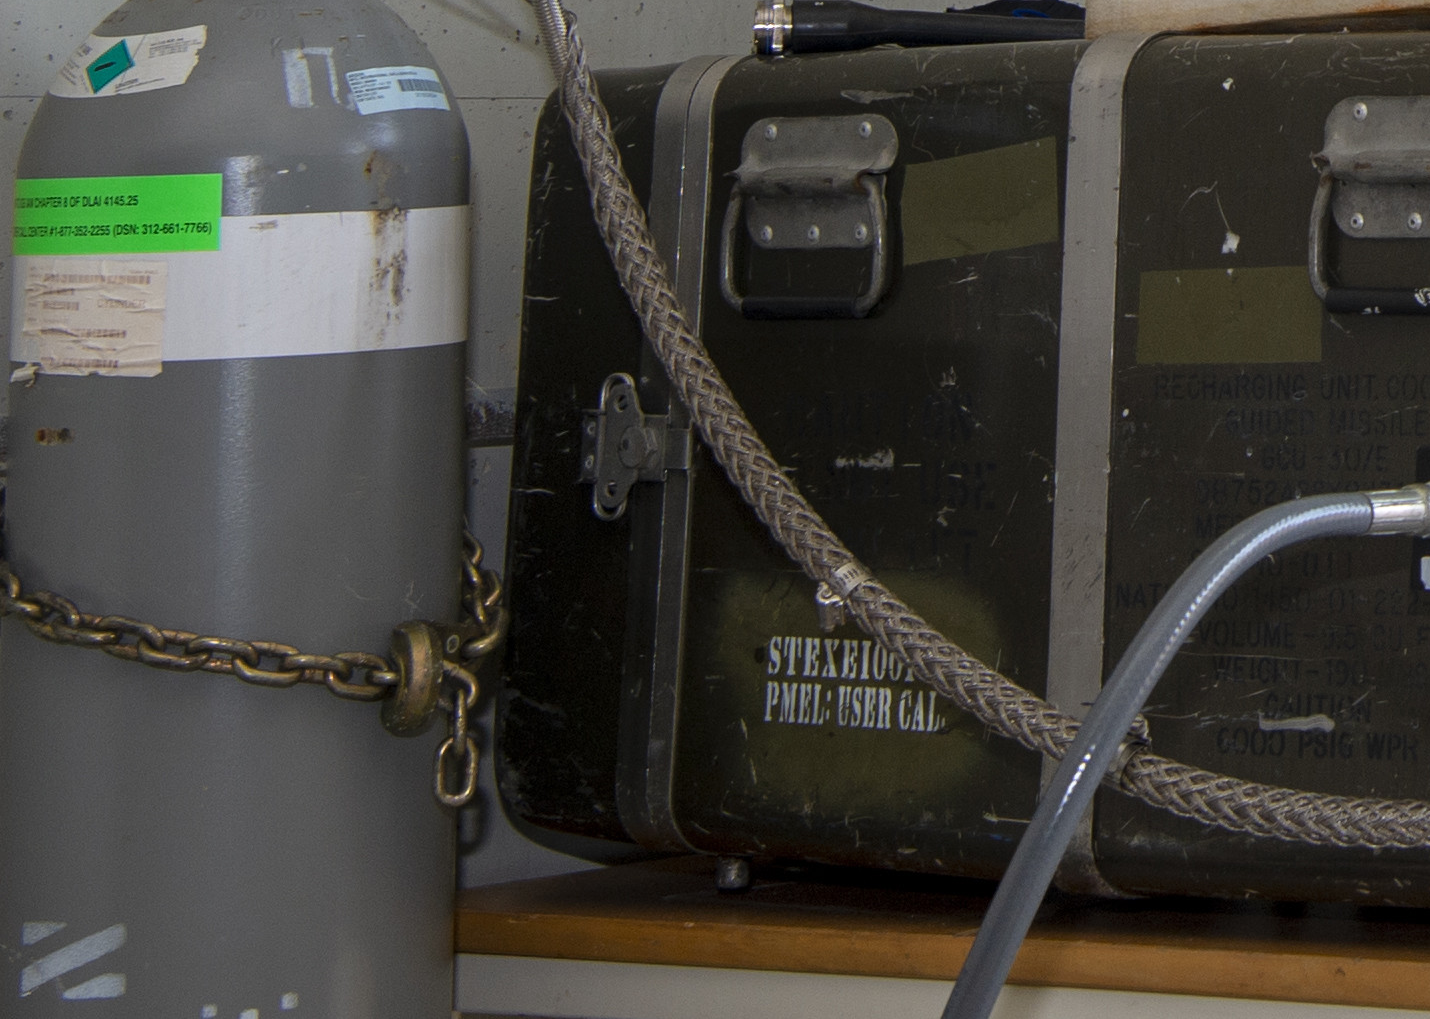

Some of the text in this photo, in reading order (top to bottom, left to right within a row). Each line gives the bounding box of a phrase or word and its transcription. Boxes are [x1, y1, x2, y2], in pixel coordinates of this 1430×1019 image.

[70, 196, 81, 208] OF
[103, 194, 139, 207] 4145.25
[112, 224, 141, 238] (DSN:
[142, 222, 214, 236] 312-661-7766)
[1153, 374, 1307, 401] RECHARGING
[1225, 409, 1429, 438] GUIDED MISSILE
[1200, 620, 1296, 650] VOLUME
[1211, 655, 1304, 686] WEIGHT
[764, 680, 833, 725] PMEL:
[836, 684, 893, 730] USER
[1297, 731, 1356, 760] PSIG
